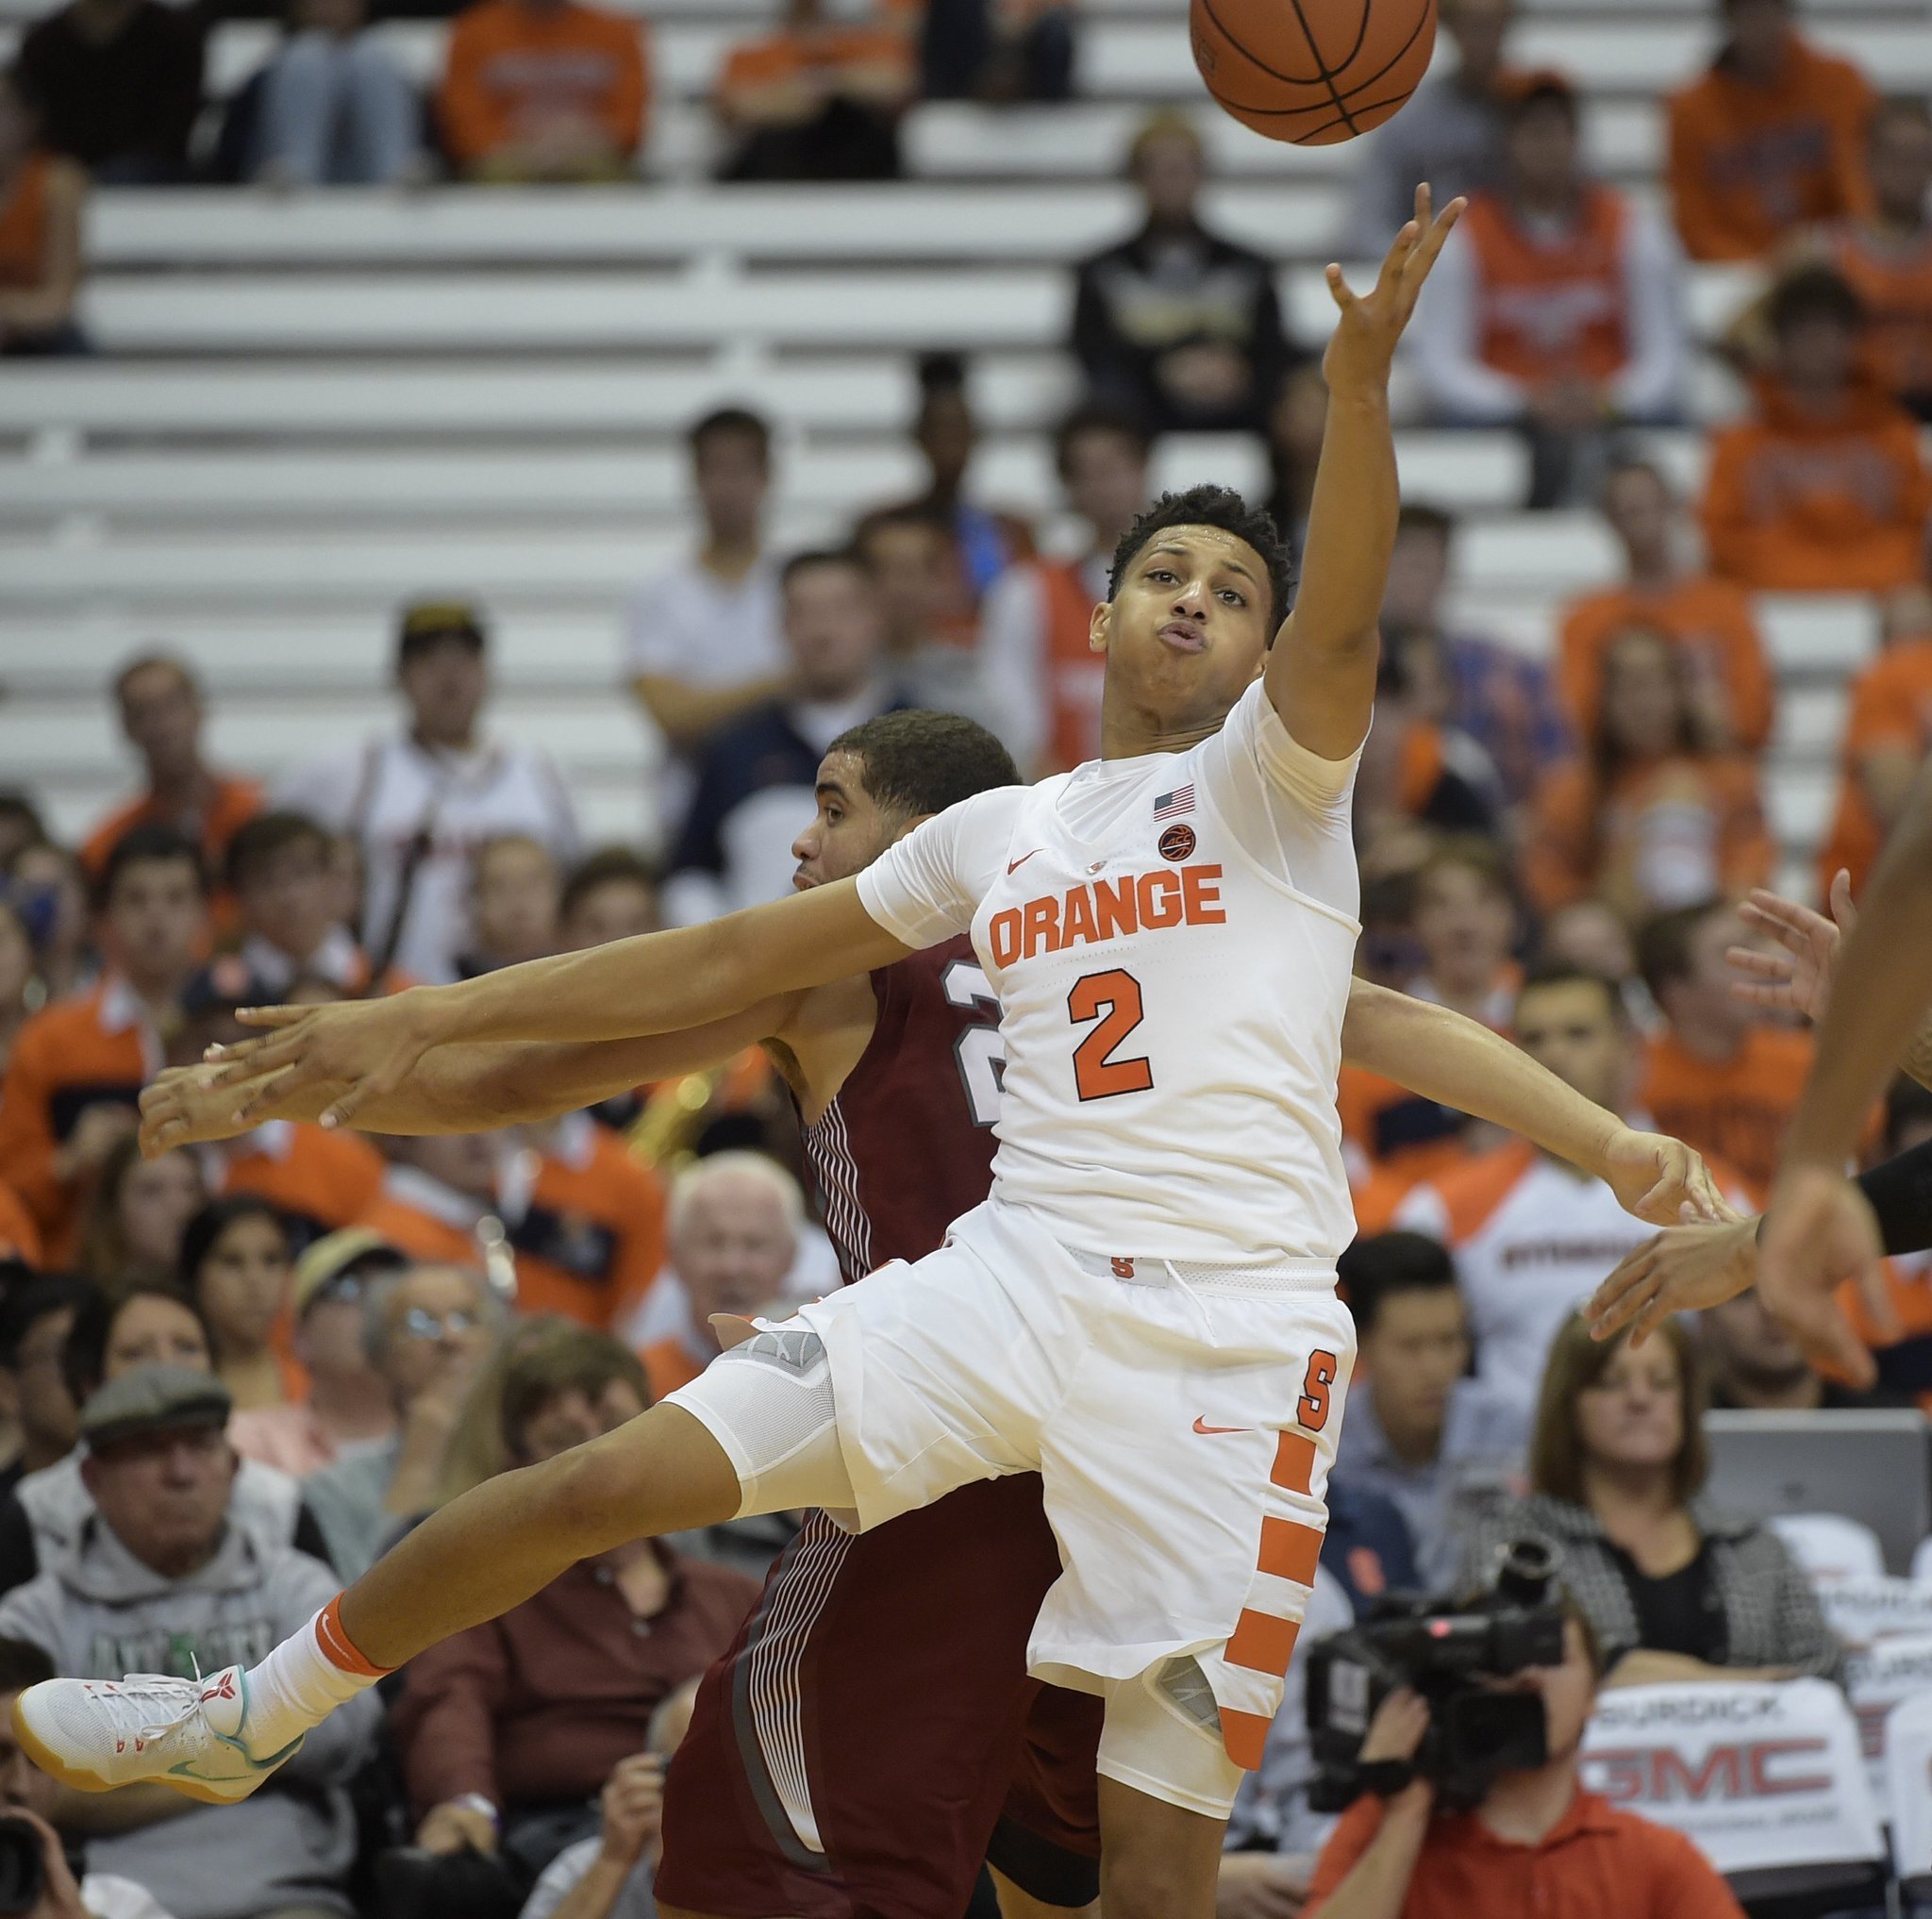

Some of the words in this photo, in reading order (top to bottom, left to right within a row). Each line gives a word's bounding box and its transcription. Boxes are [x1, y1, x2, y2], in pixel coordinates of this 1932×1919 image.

[989, 864, 1226, 970] ORANGE
[1067, 968, 1154, 1102] 2
[1110, 1256, 1135, 1279] S
[1296, 1348, 1337, 1432] S
[1579, 1737, 1834, 1804] GMC
